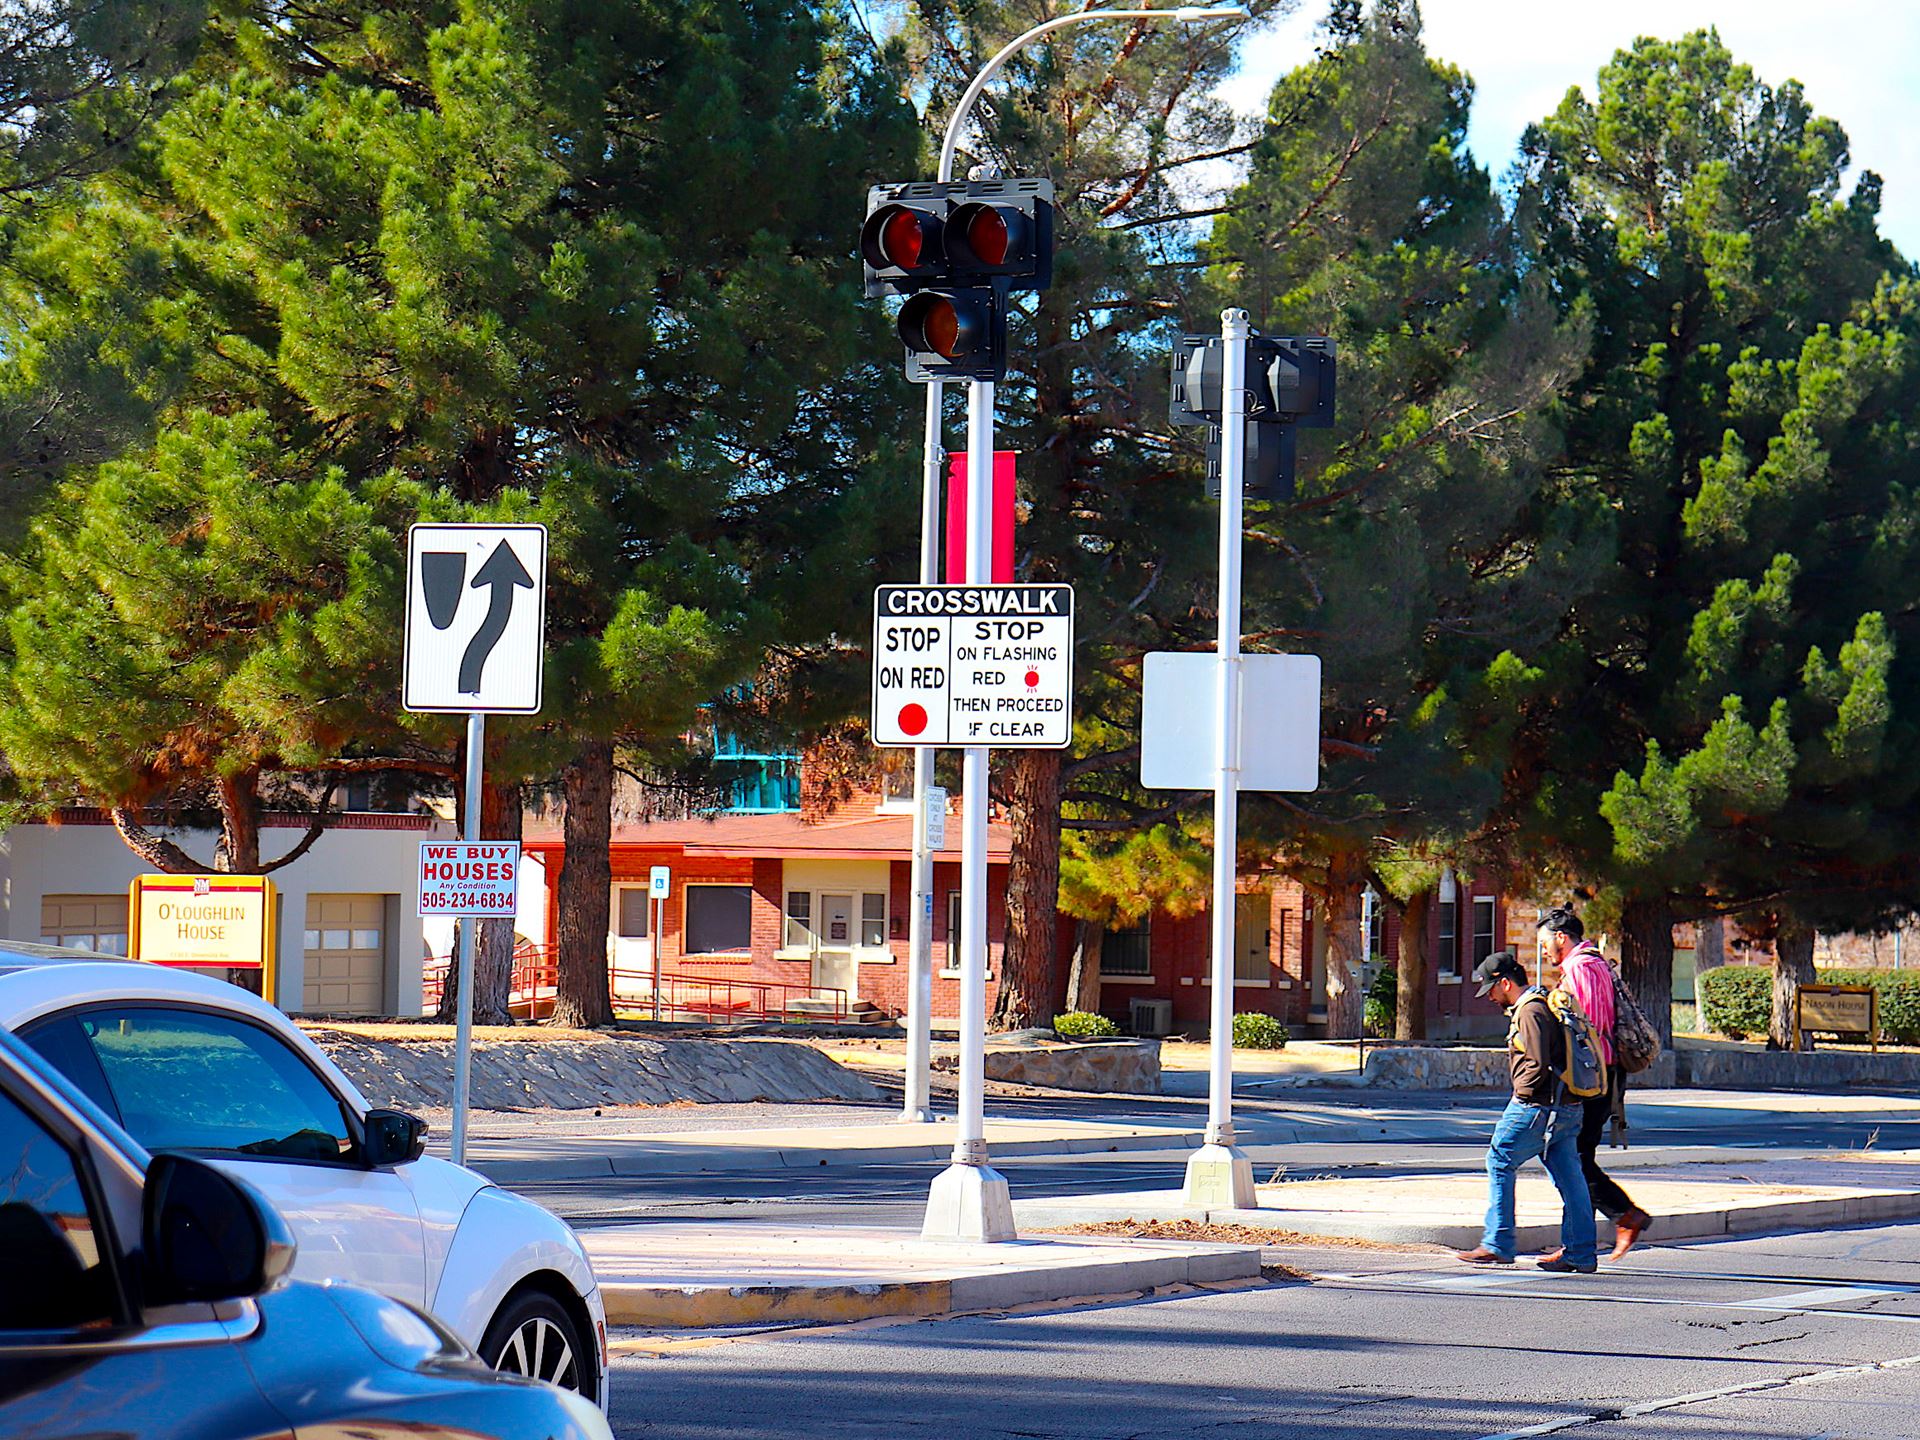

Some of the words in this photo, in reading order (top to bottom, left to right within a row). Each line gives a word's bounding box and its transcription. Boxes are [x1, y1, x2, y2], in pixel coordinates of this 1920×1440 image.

[888, 589, 1058, 614] CROSSWALK
[975, 621, 1044, 640] STOP
[886, 627, 940, 652] STOP
[957, 647, 977, 660] ON
[984, 647, 1057, 660] FLASHING
[880, 667, 903, 689] ON
[911, 667, 945, 689] RED
[973, 671, 1006, 685] RED
[954, 698, 990, 712] THEN
[997, 698, 1063, 712] PROCEED
[969, 722, 983, 736] IF
[989, 722, 1044, 736] CLEAR
[427, 847, 457, 859] WE
[467, 847, 510, 859] BUY
[423, 862, 513, 880] HOUSES
[440, 882, 455, 890] Any
[457, 882, 496, 890] Condition
[422, 892, 513, 908] 505-234-6834
[177, 923, 225, 940] HOUSE
